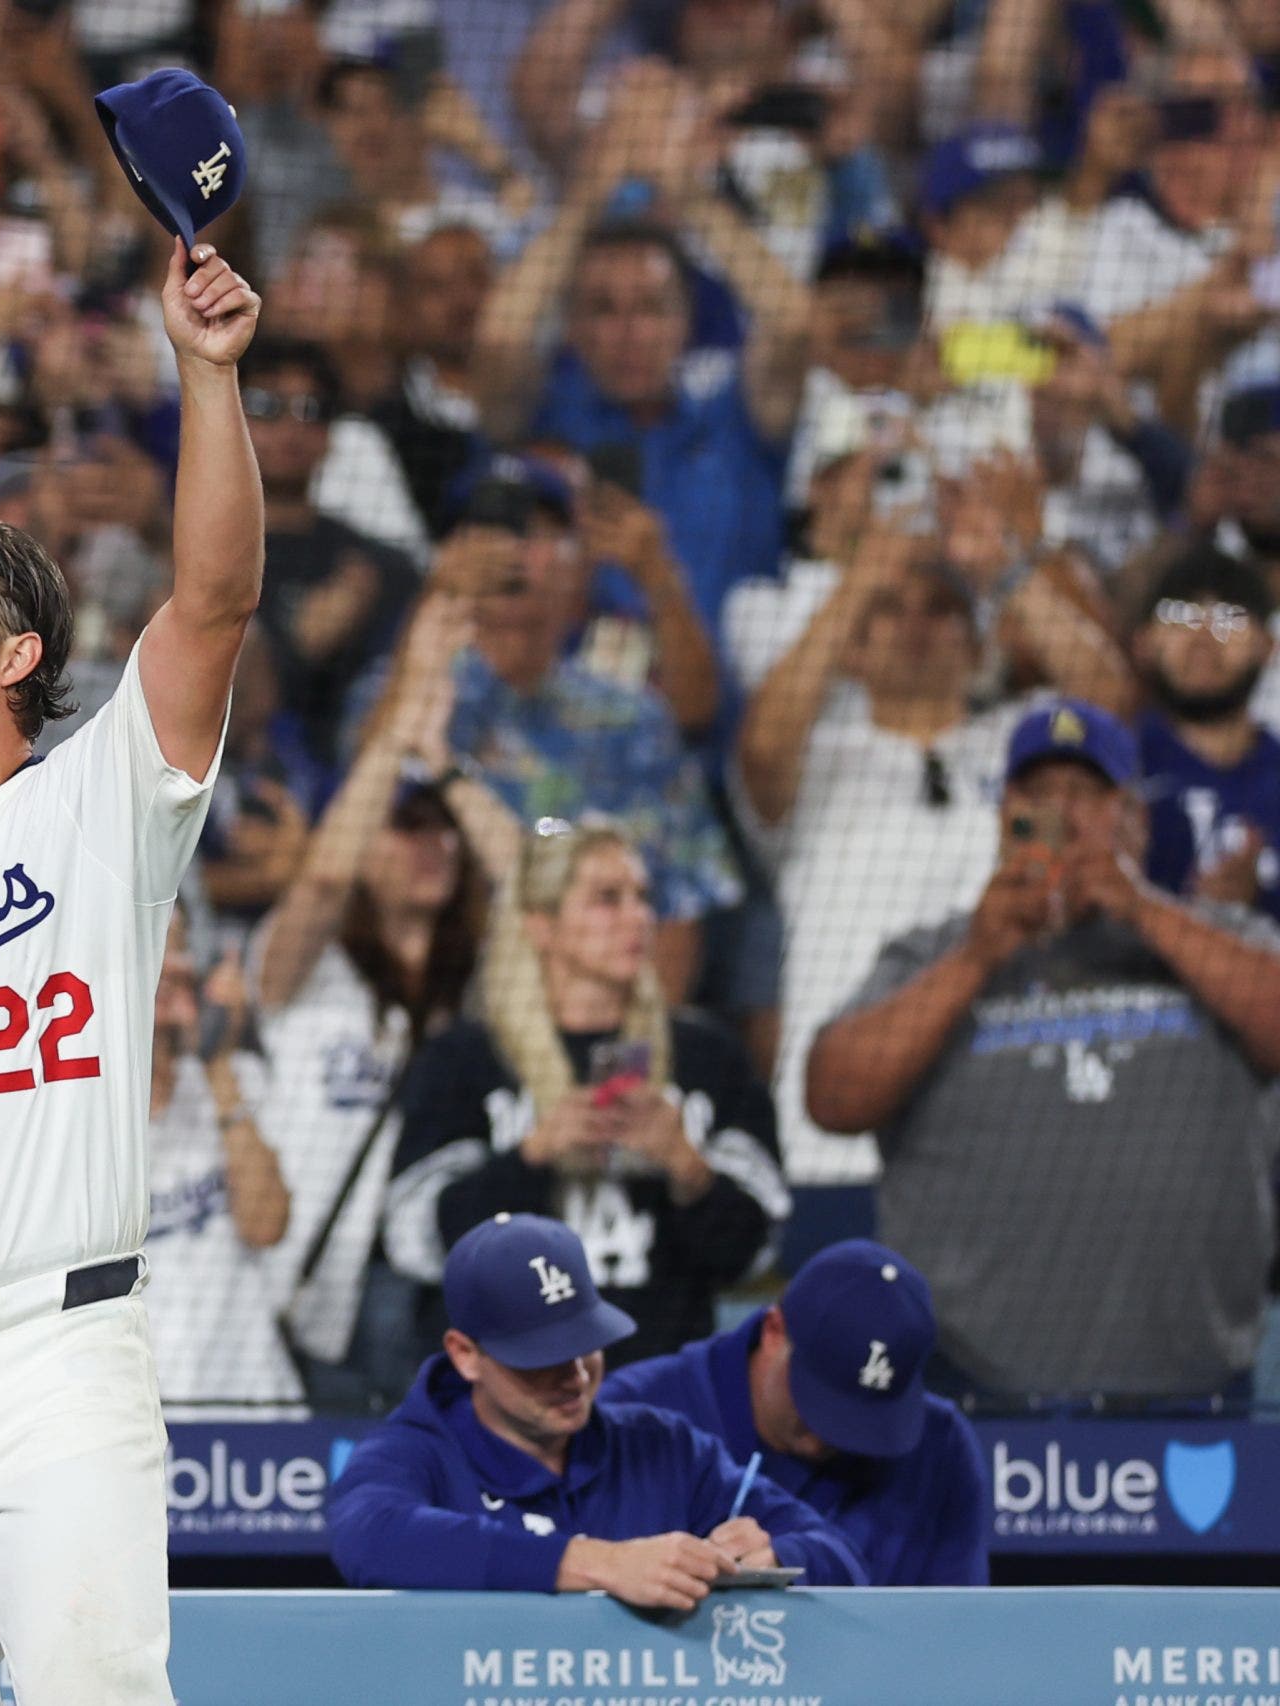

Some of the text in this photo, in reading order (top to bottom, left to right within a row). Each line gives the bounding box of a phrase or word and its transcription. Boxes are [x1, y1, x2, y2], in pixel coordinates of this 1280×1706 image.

[191, 141, 232, 200] LA
[528, 1255, 577, 1305] LA
[858, 1340, 895, 1391] LA
[164, 1438, 327, 1512] blue
[994, 1441, 1159, 1514] blue
[463, 1649, 700, 1687] MERRILL
